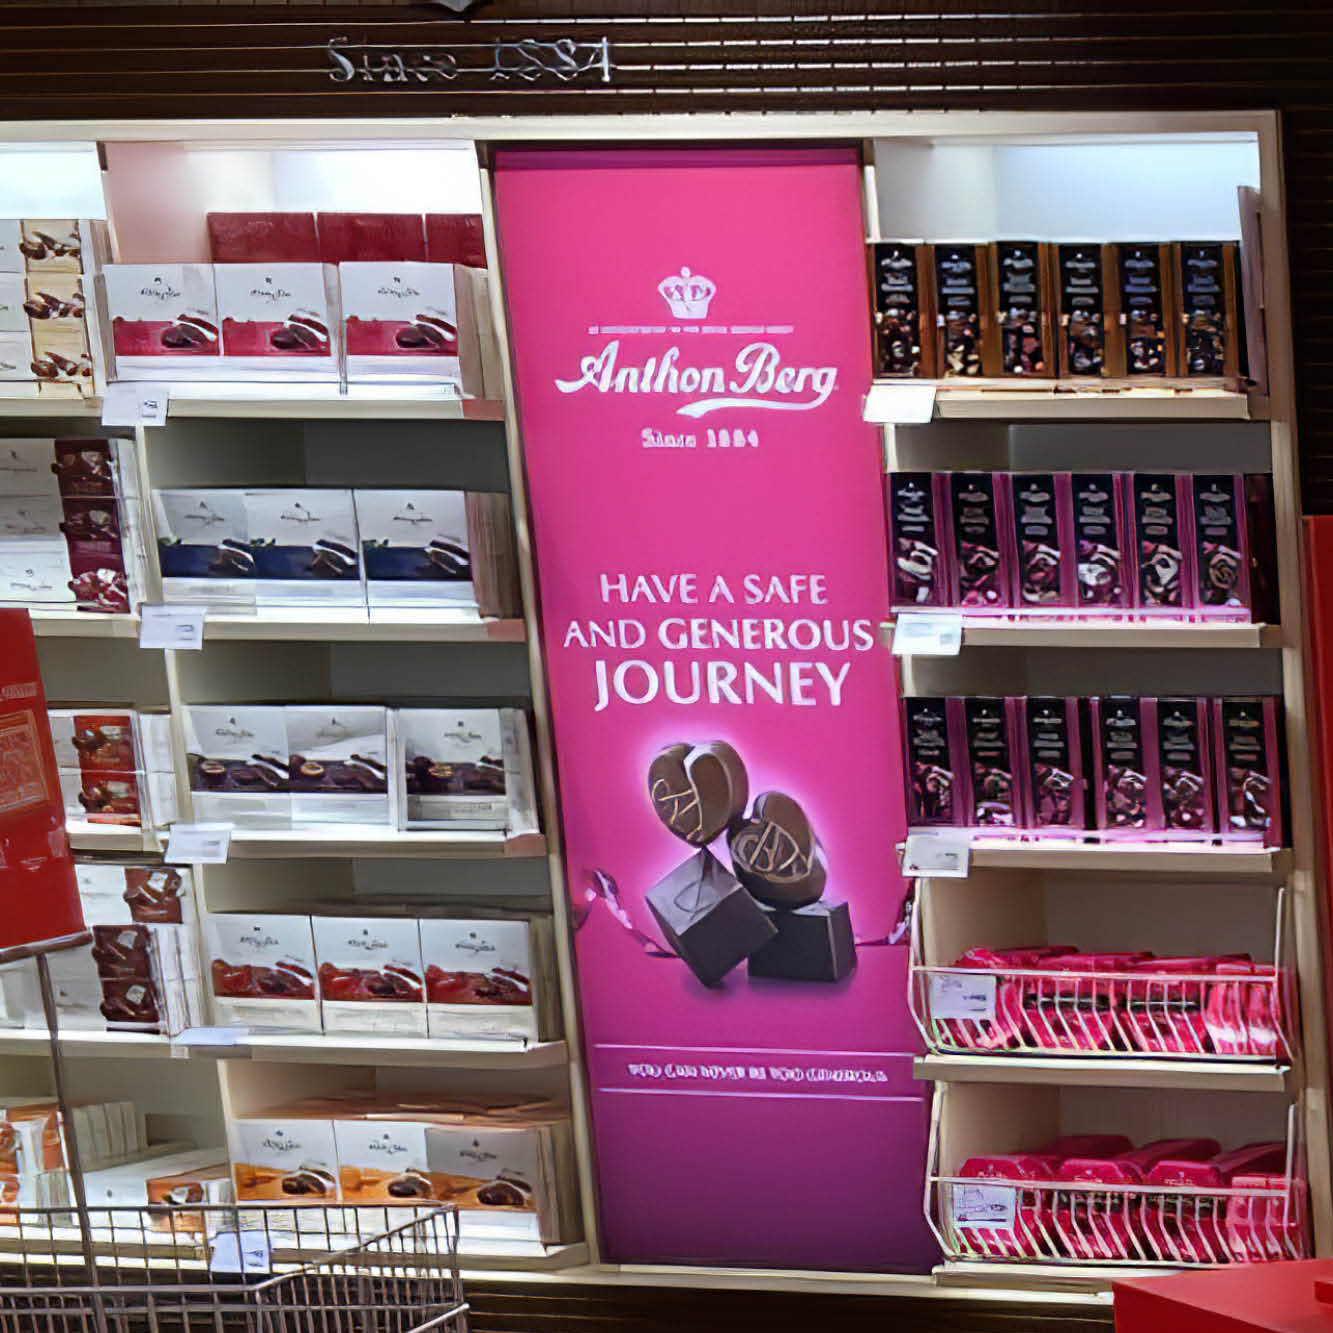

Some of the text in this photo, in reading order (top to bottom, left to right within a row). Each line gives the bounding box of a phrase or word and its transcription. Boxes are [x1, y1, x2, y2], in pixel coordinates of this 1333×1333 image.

[554, 340, 839, 411] Anthon Berg
[599, 573, 828, 605] HAVE A SAFE
[563, 618, 875, 652] AND GENEROUS
[594, 659, 851, 711] JOURNEY
